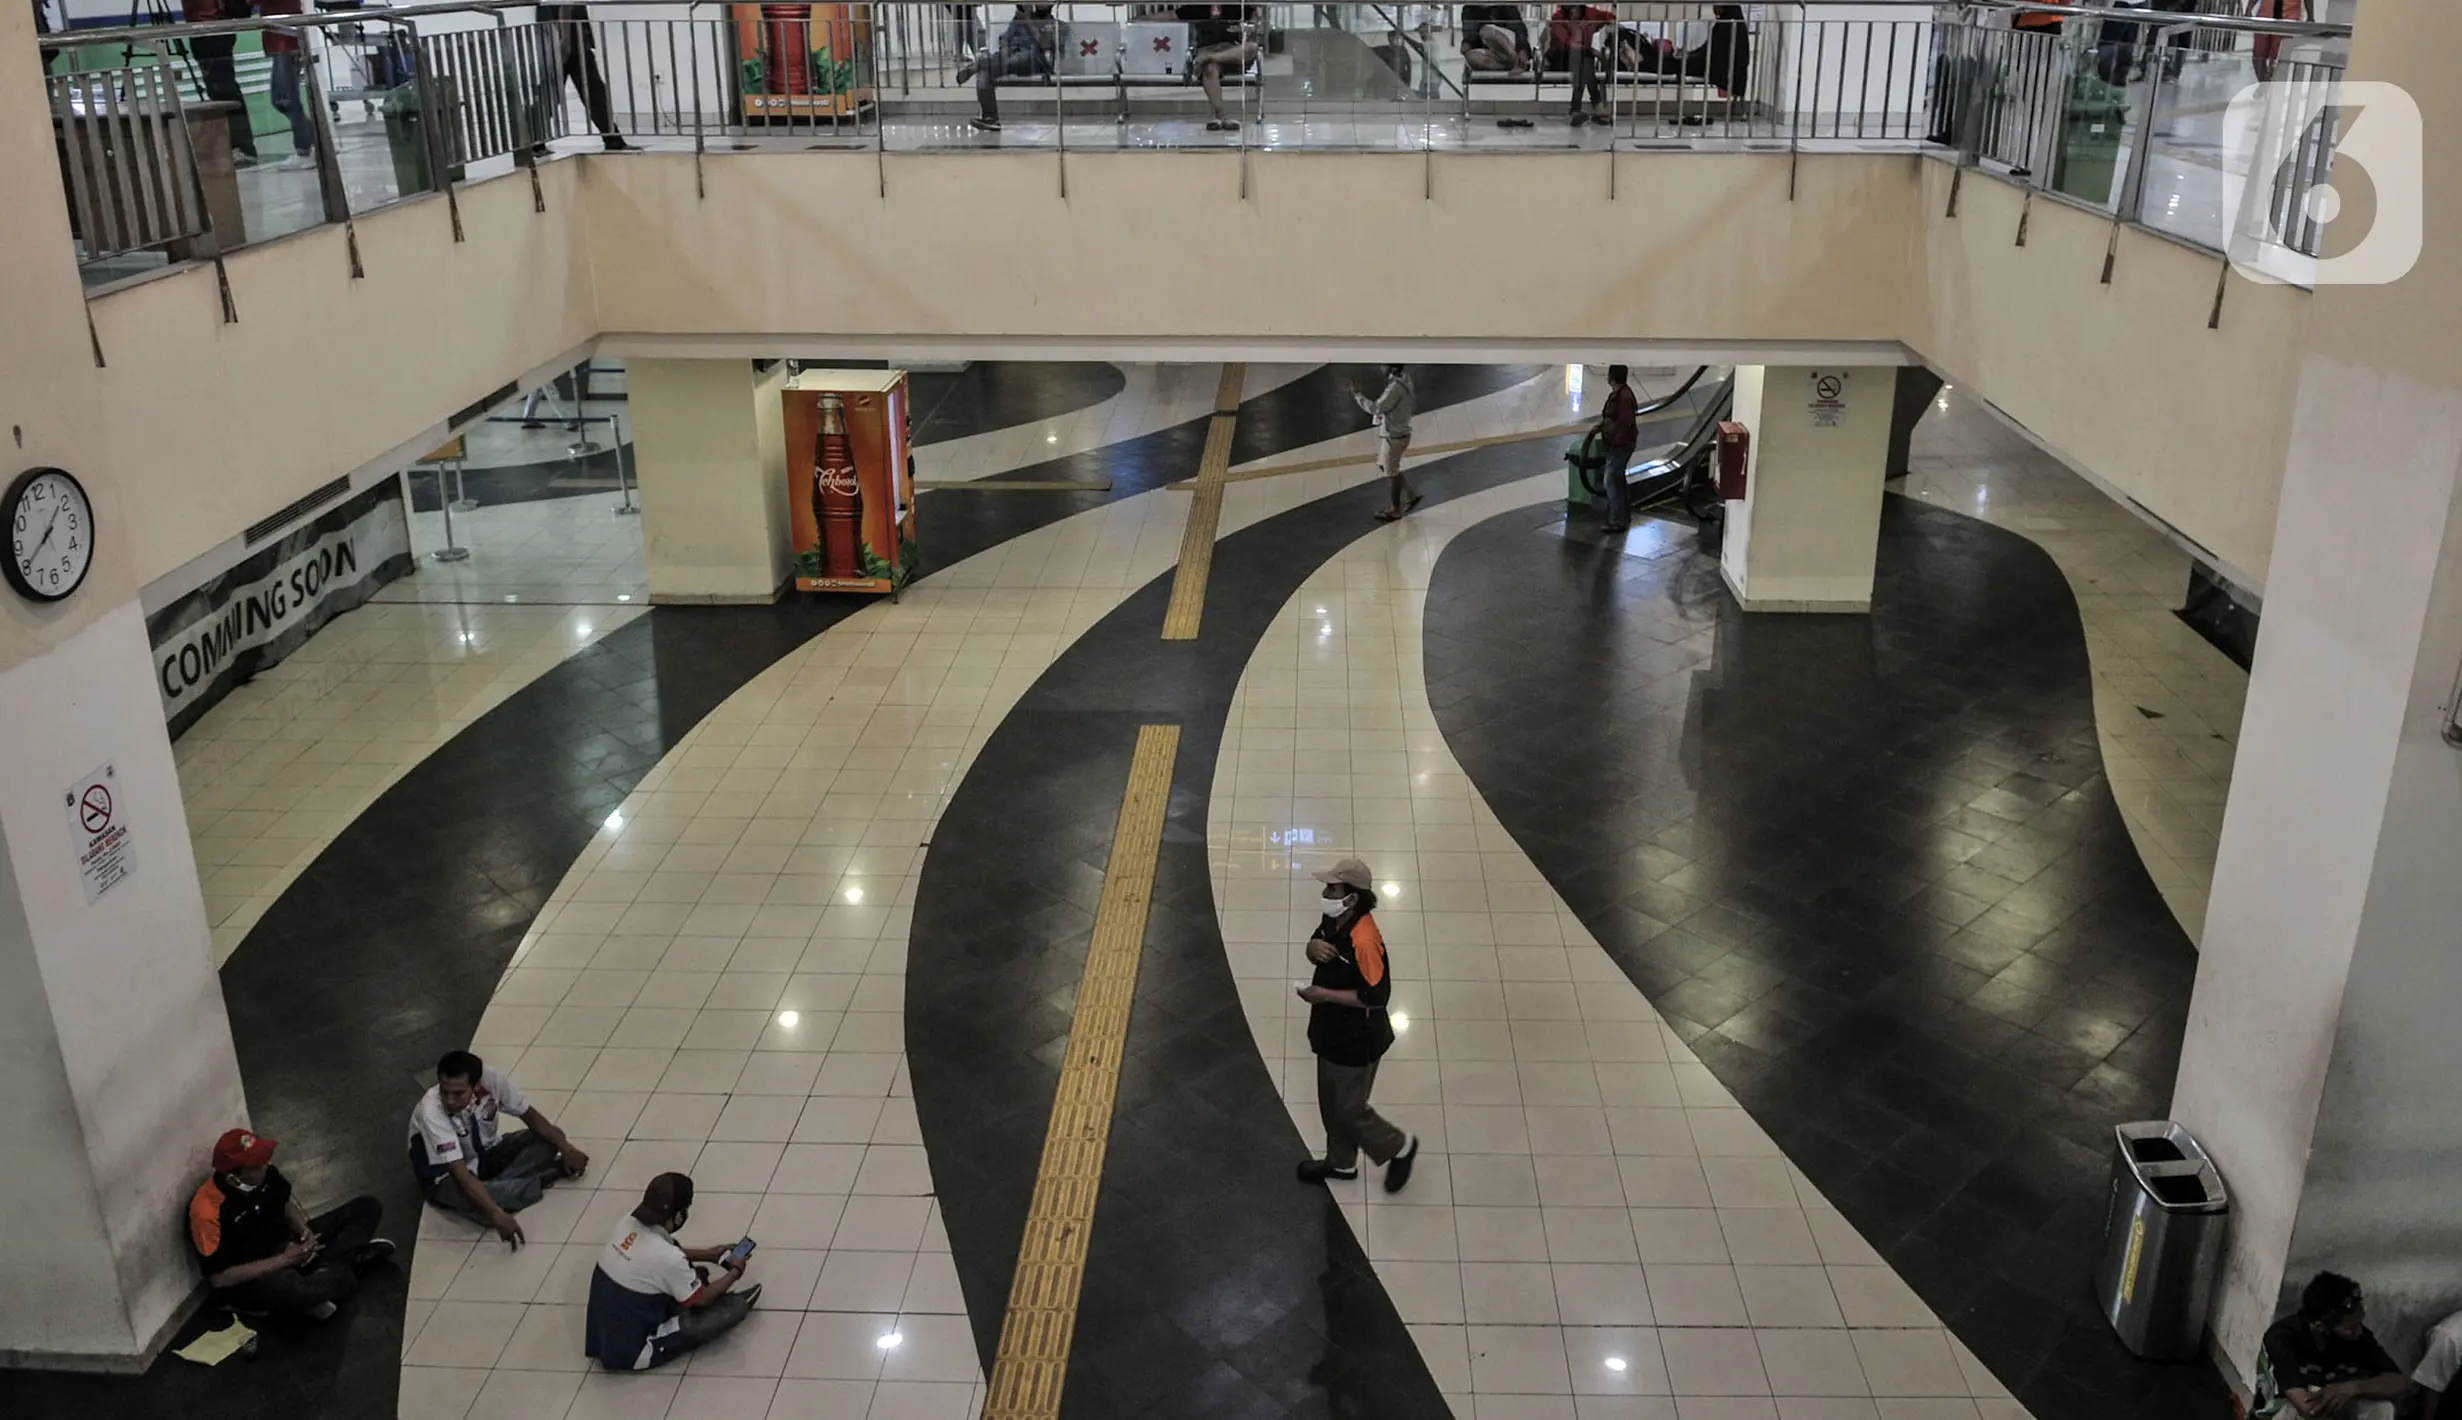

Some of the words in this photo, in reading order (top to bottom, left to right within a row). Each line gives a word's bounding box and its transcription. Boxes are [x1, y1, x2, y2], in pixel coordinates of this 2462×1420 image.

[31, 483, 45, 501] 12
[49, 483, 56, 500] 1
[61, 494, 70, 512] 2
[68, 513, 77, 530] 3
[14, 540, 23, 556] 9
[68, 535, 78, 551] 4
[22, 559, 32, 575] 8
[61, 555, 71, 572] 5
[36, 568, 44, 585] 7
[50, 568, 60, 585] 6
[290, 537, 357, 608] SOON
